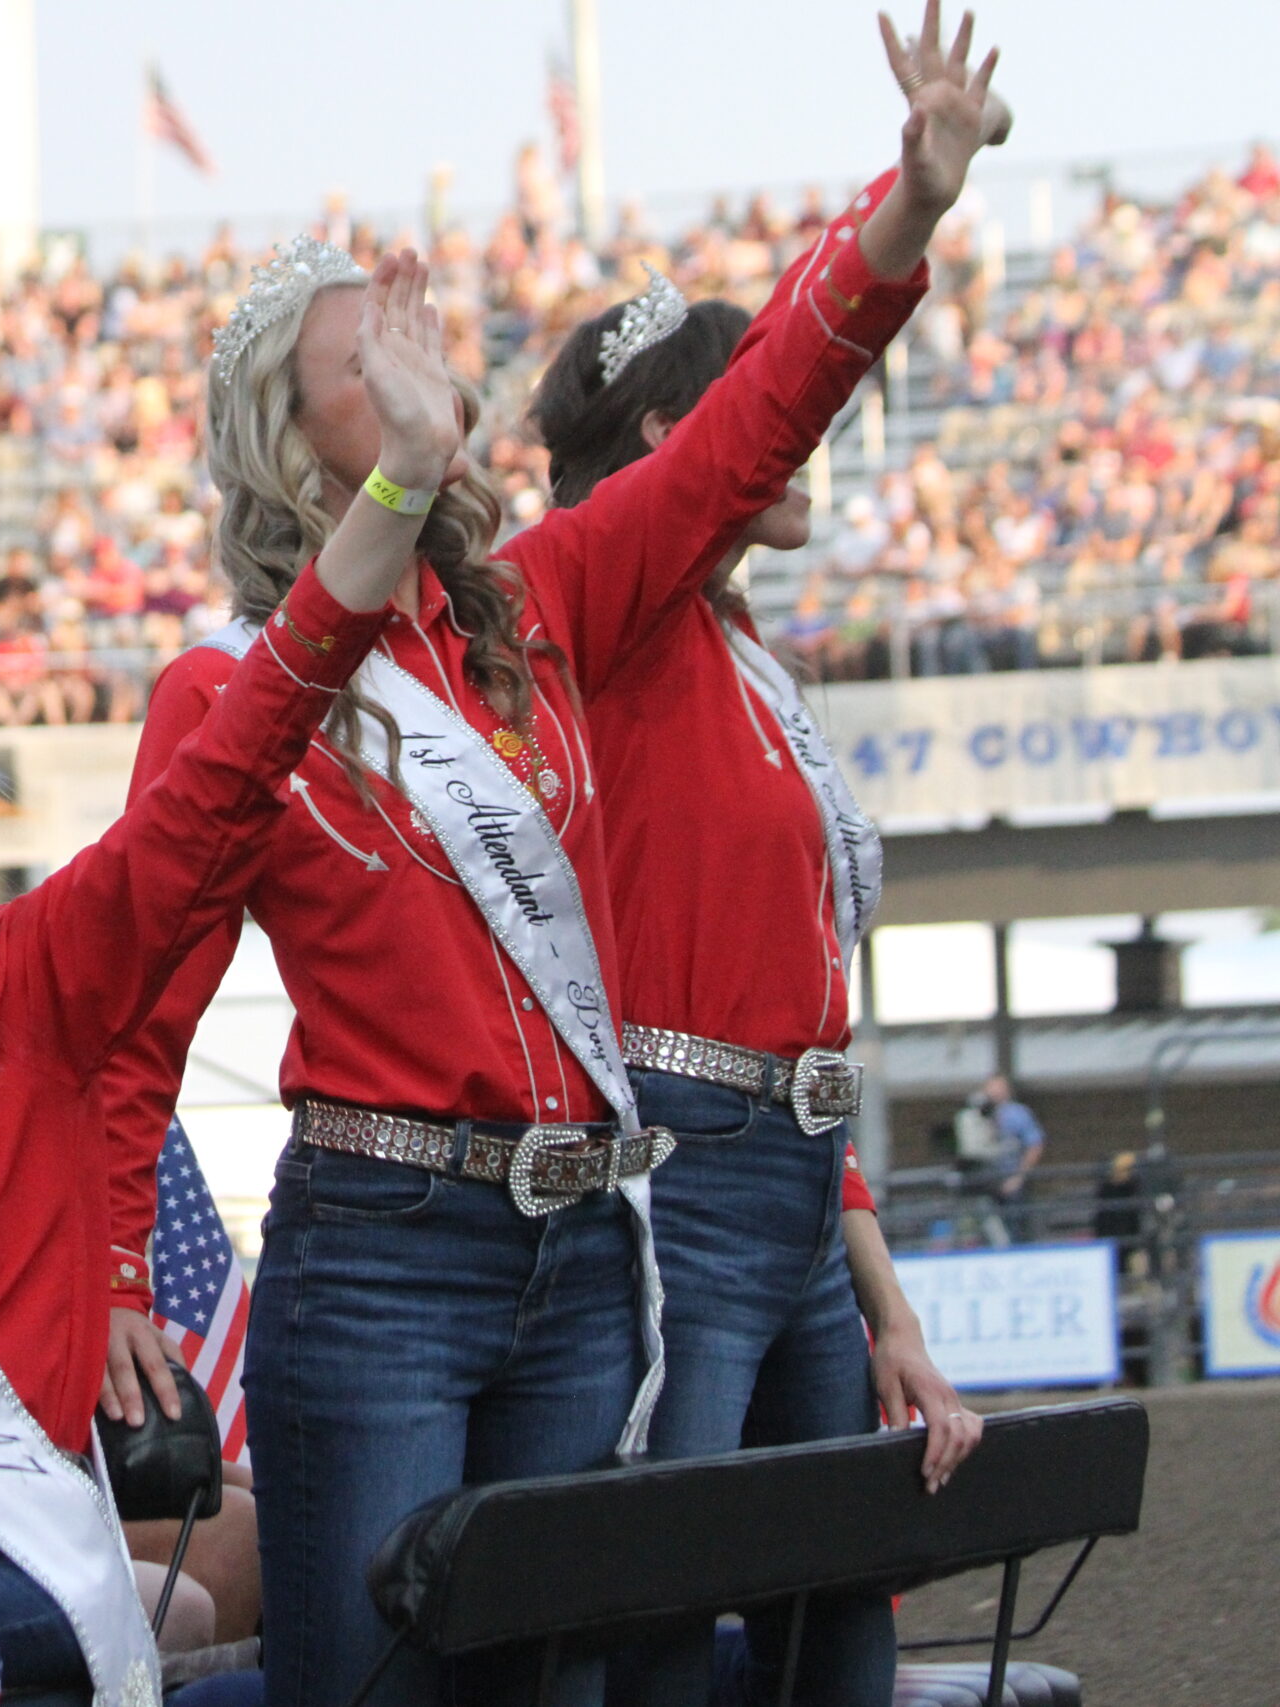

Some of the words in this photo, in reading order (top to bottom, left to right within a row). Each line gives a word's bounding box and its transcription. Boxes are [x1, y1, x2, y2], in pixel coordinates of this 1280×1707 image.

[851, 731, 933, 777] 47
[968, 706, 1280, 769] COWBO
[401, 731, 456, 769] 1st
[446, 780, 558, 927] Attendant
[567, 979, 614, 1075] Days
[928, 1293, 1089, 1346] LLER
